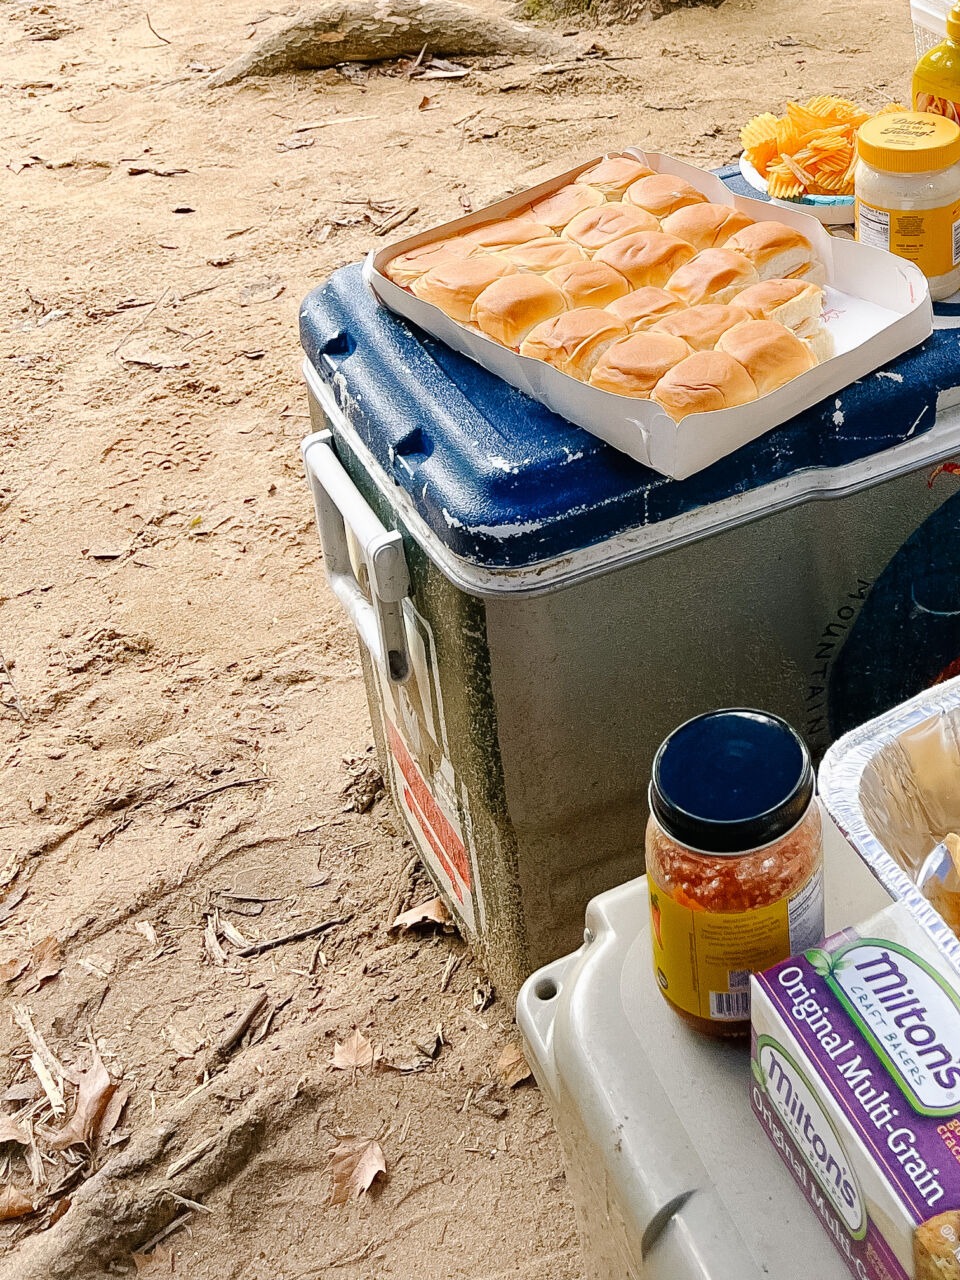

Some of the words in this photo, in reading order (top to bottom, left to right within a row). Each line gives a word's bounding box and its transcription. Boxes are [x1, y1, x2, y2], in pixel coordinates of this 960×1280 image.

[778, 966, 854, 1060] Original
[846, 1052, 945, 1208] Multi-Grain
[849, 985, 887, 1030] CRAFT
[885, 1033, 927, 1087] BAKERS
[753, 1087, 808, 1187] Original
[768, 1050, 857, 1209] milton's
